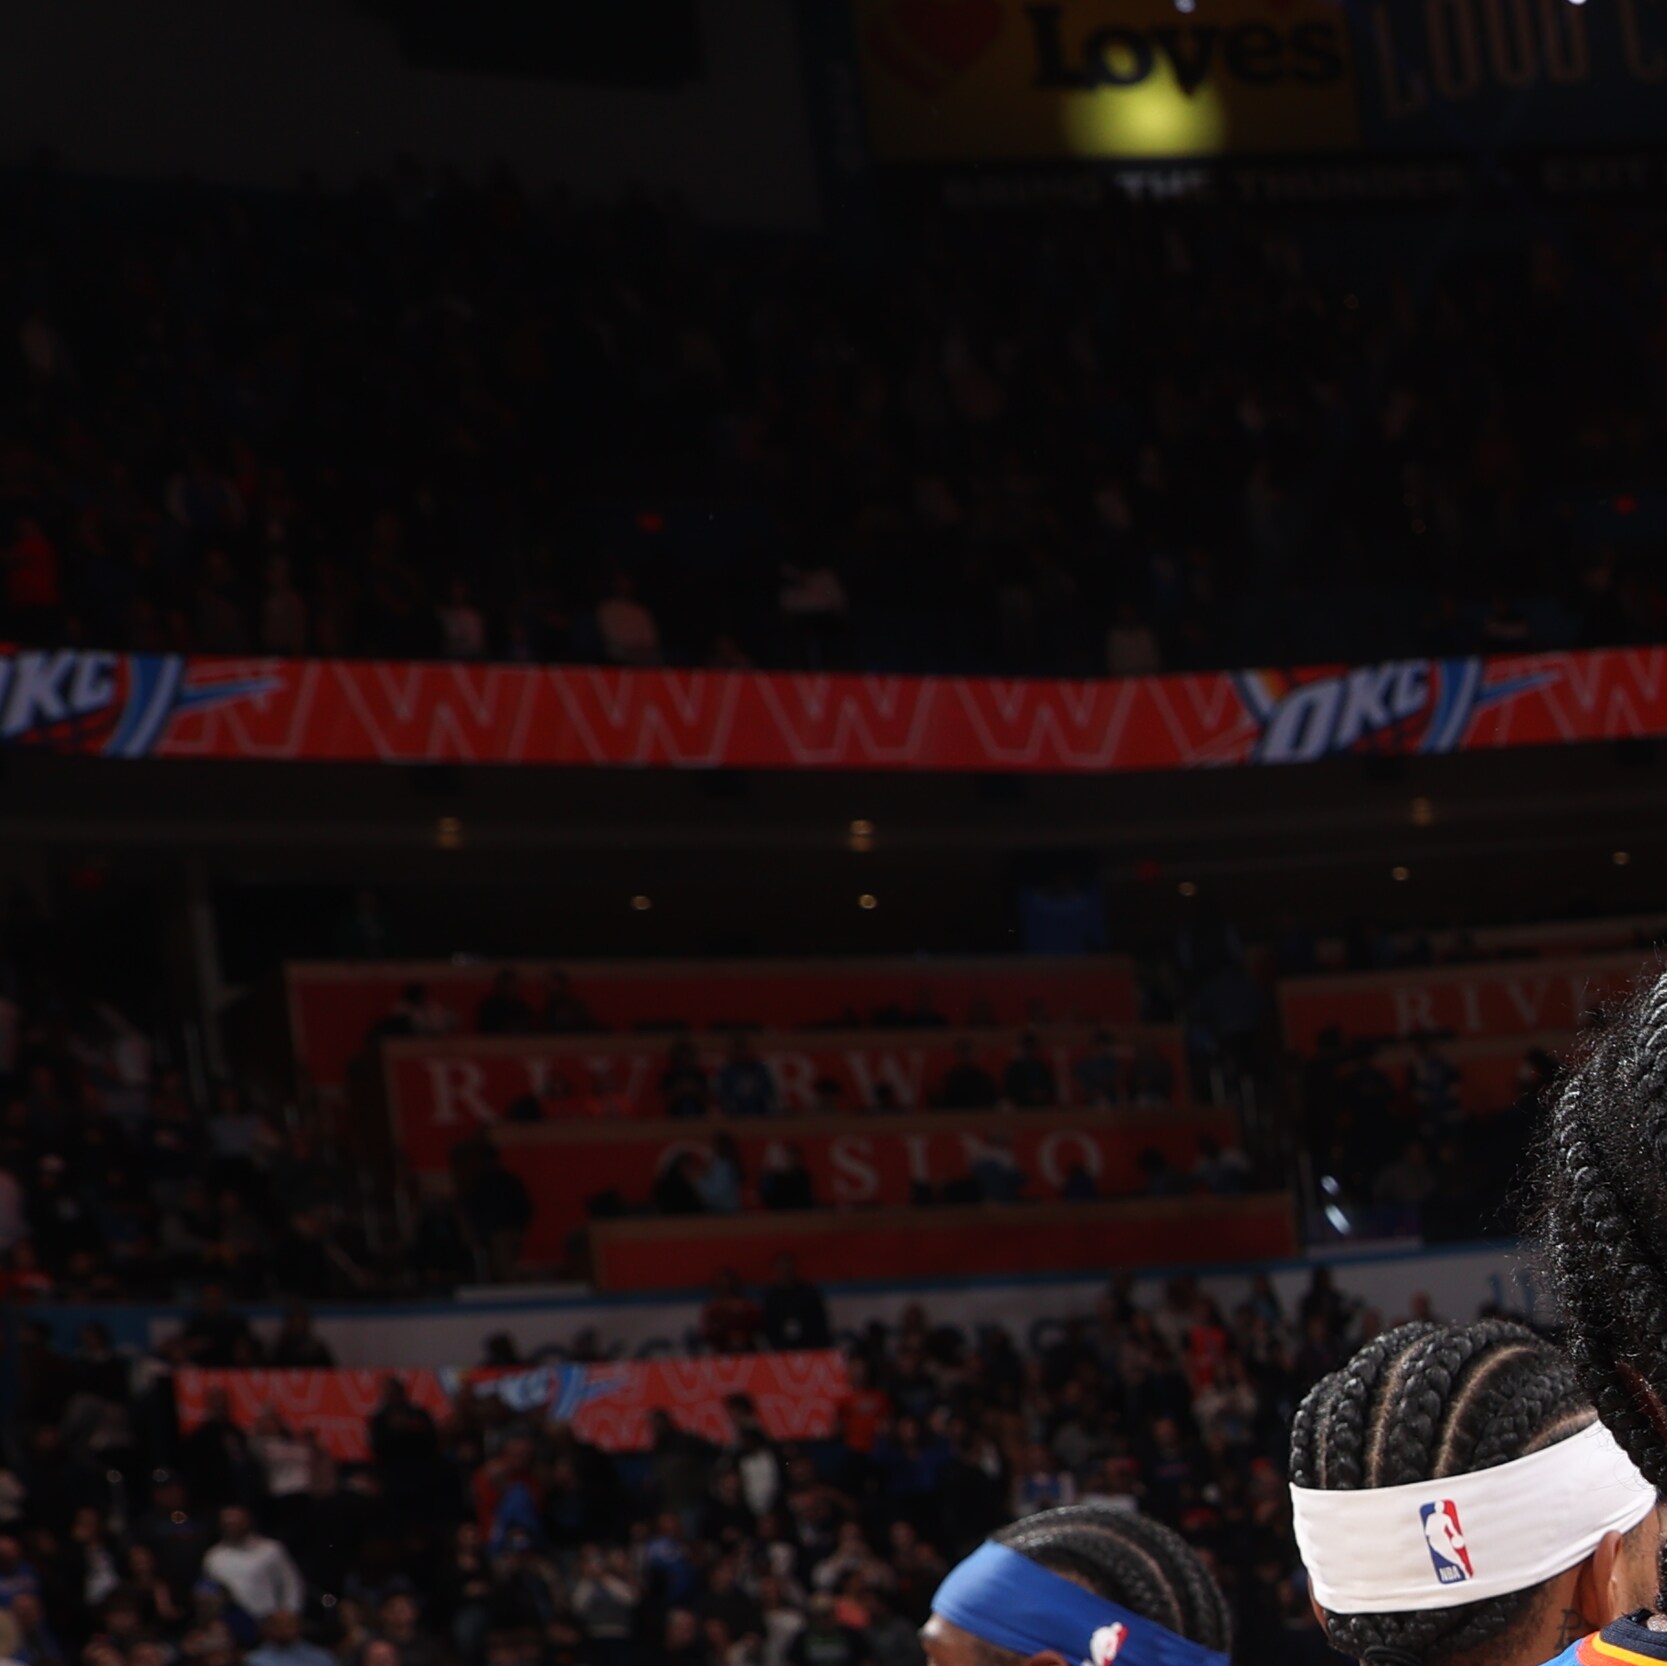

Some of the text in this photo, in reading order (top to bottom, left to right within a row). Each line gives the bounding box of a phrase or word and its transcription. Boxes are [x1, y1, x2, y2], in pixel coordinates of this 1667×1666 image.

[0, 649, 121, 736] KC
[1256, 657, 1432, 767] OKC
[1439, 1564, 1463, 1582] NBA
